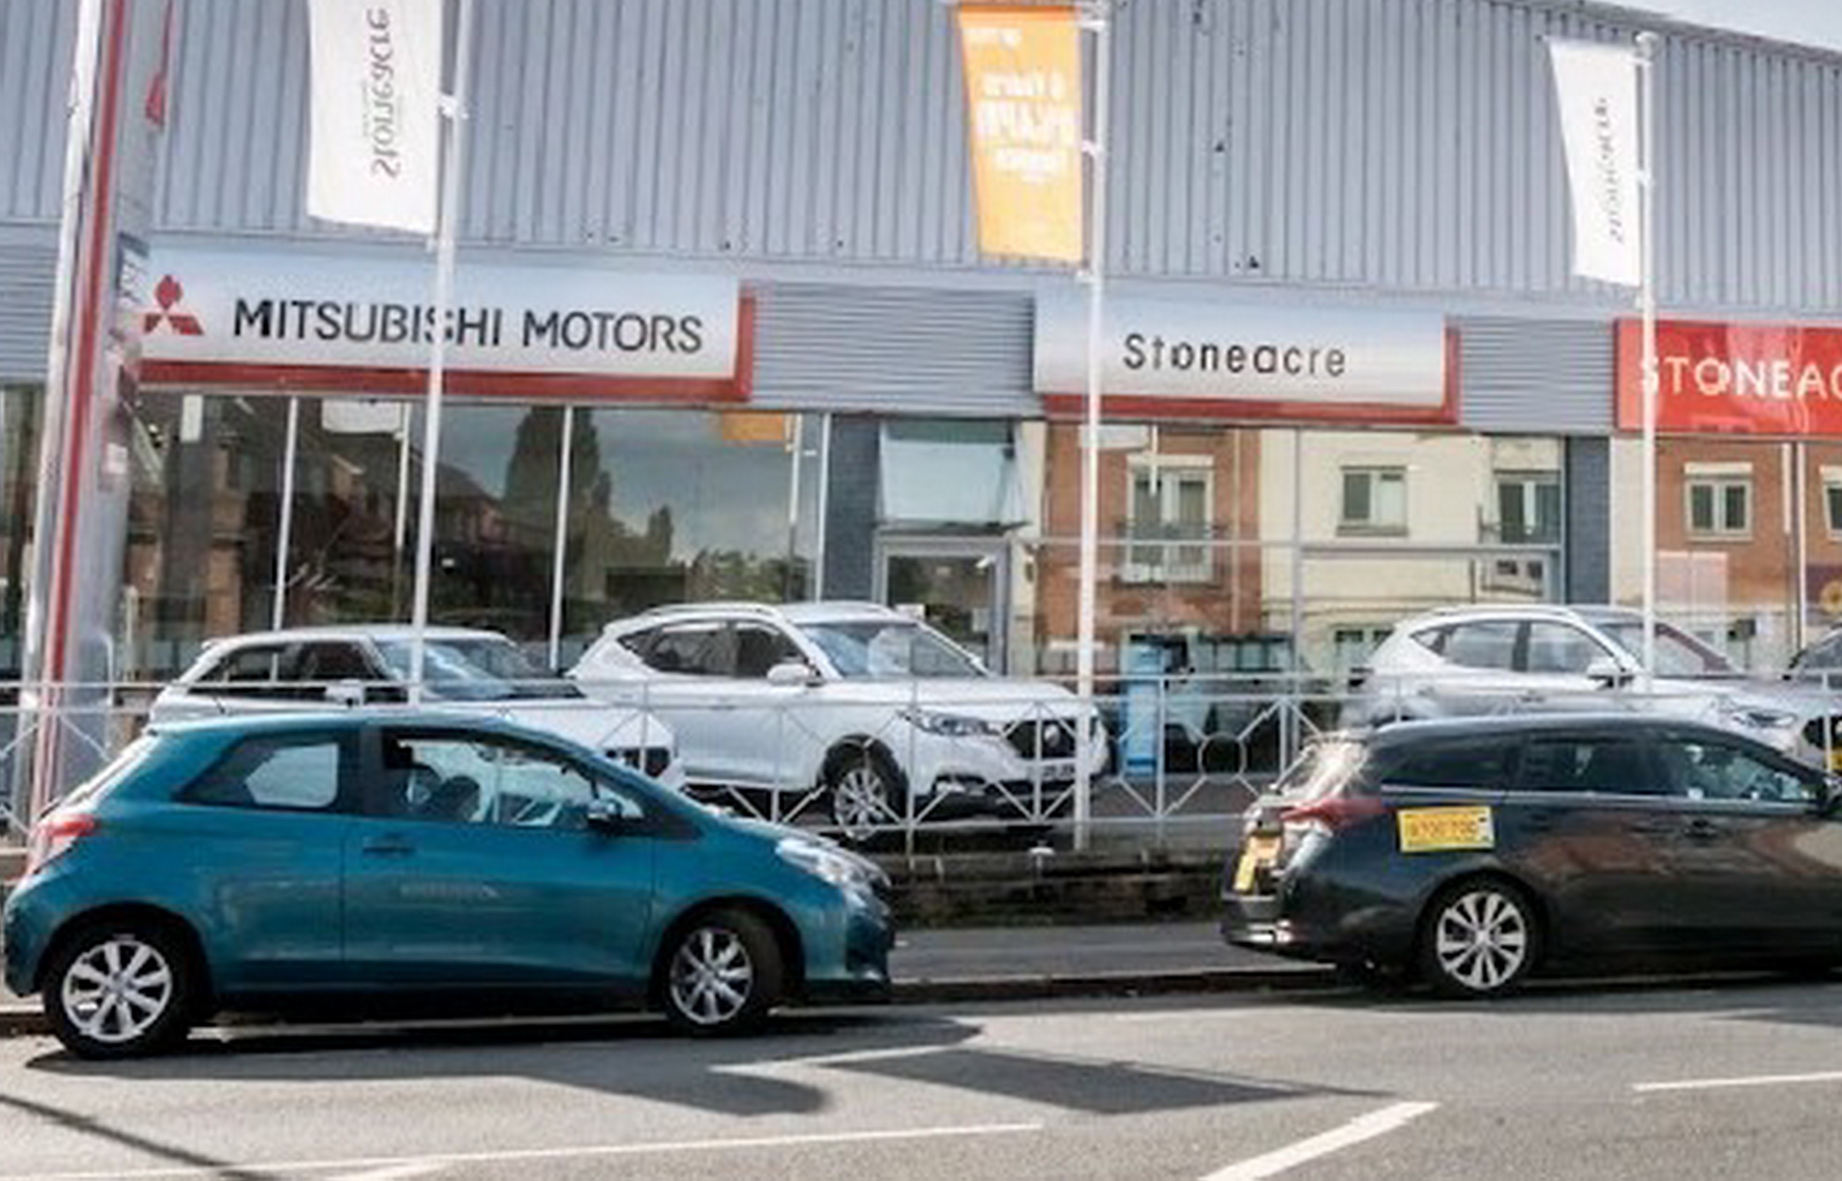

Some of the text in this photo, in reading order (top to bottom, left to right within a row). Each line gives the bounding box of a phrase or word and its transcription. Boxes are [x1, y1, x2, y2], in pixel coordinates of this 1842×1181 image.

[233, 296, 704, 354] MITSUBISHI MOTORS
[1122, 332, 1347, 378] Stoneacre
